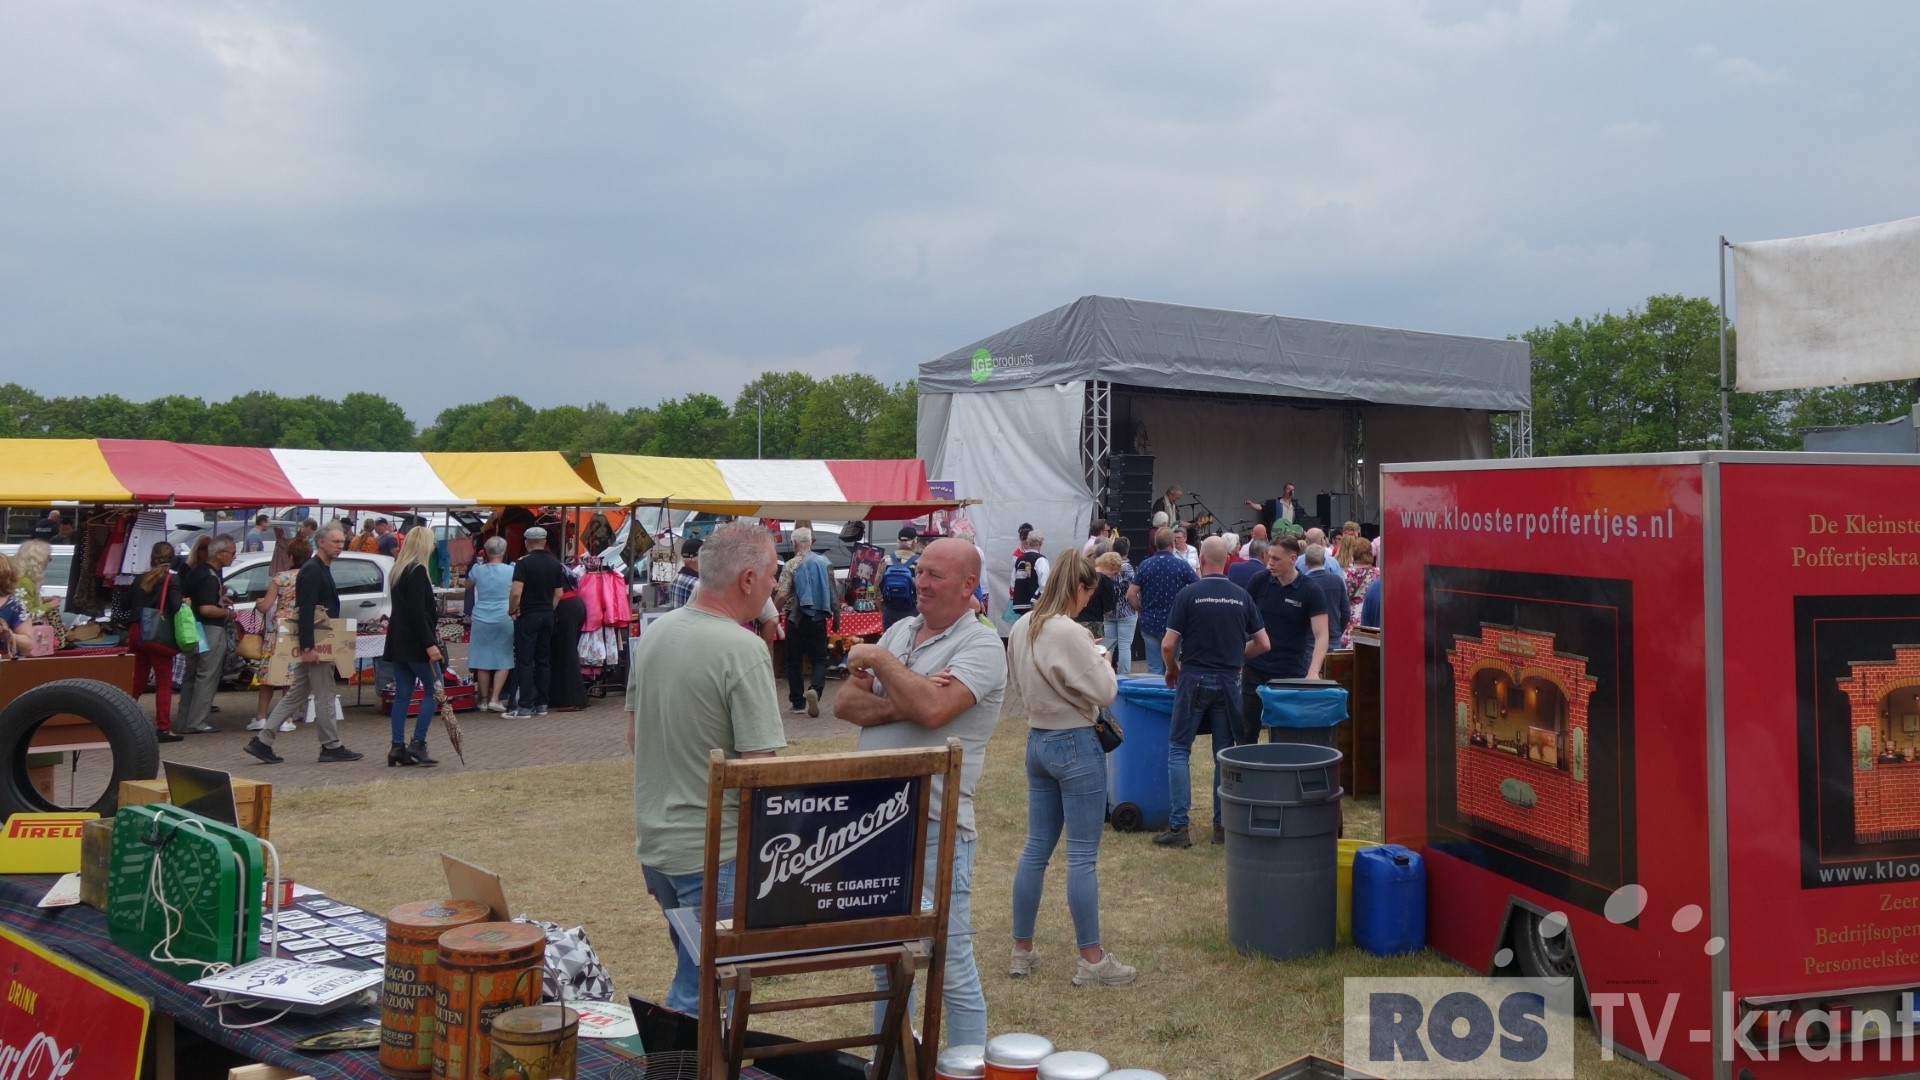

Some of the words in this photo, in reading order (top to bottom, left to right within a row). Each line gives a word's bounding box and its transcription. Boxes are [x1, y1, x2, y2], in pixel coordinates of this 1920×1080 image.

[1400, 505, 1673, 543] www.kloosterpoffertjes.nl
[1808, 514, 1838, 534] De
[1844, 514, 1920, 534] Kleinste
[1791, 546, 1920, 573] Poffertjeskra
[766, 795, 849, 816] SMOKE
[8, 819, 82, 838] PIRELL
[756, 781, 910, 900] Piedmont
[1819, 860, 1920, 883] www.kloo
[836, 876, 901, 892] CIGARETTE
[817, 898, 834, 910] OF
[1880, 894, 1918, 911] Zeer
[1815, 923, 1920, 946] Bedrijfsopen
[1804, 949, 1919, 975] Personeelsfee
[8, 980, 38, 1015] DRINK
